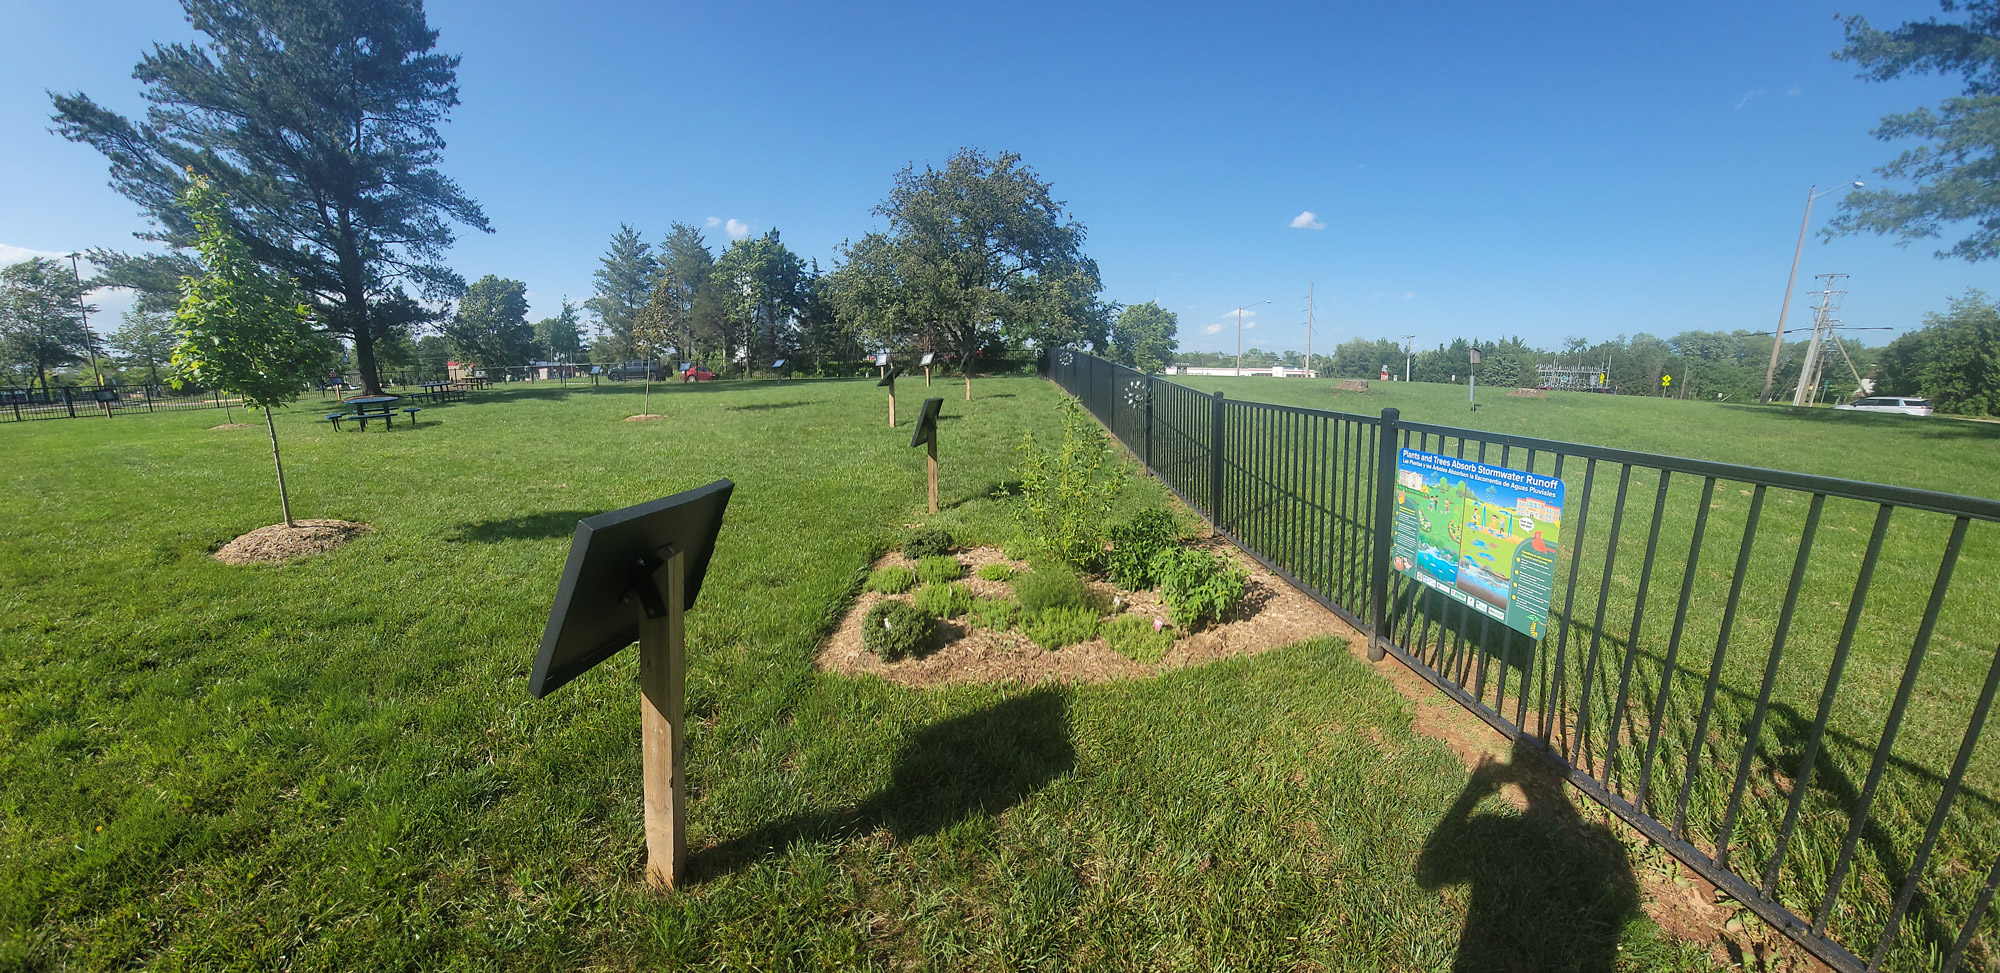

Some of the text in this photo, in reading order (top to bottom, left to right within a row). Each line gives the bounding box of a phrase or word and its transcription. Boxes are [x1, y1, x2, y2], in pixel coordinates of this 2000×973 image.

[1403, 449, 1558, 489] Plants and Trees Absorb Stormwater Runoff
[1448, 468, 1469, 478] Absorben
[1511, 483, 1528, 492] Aguas
[1529, 487, 1556, 498] Pluviales
